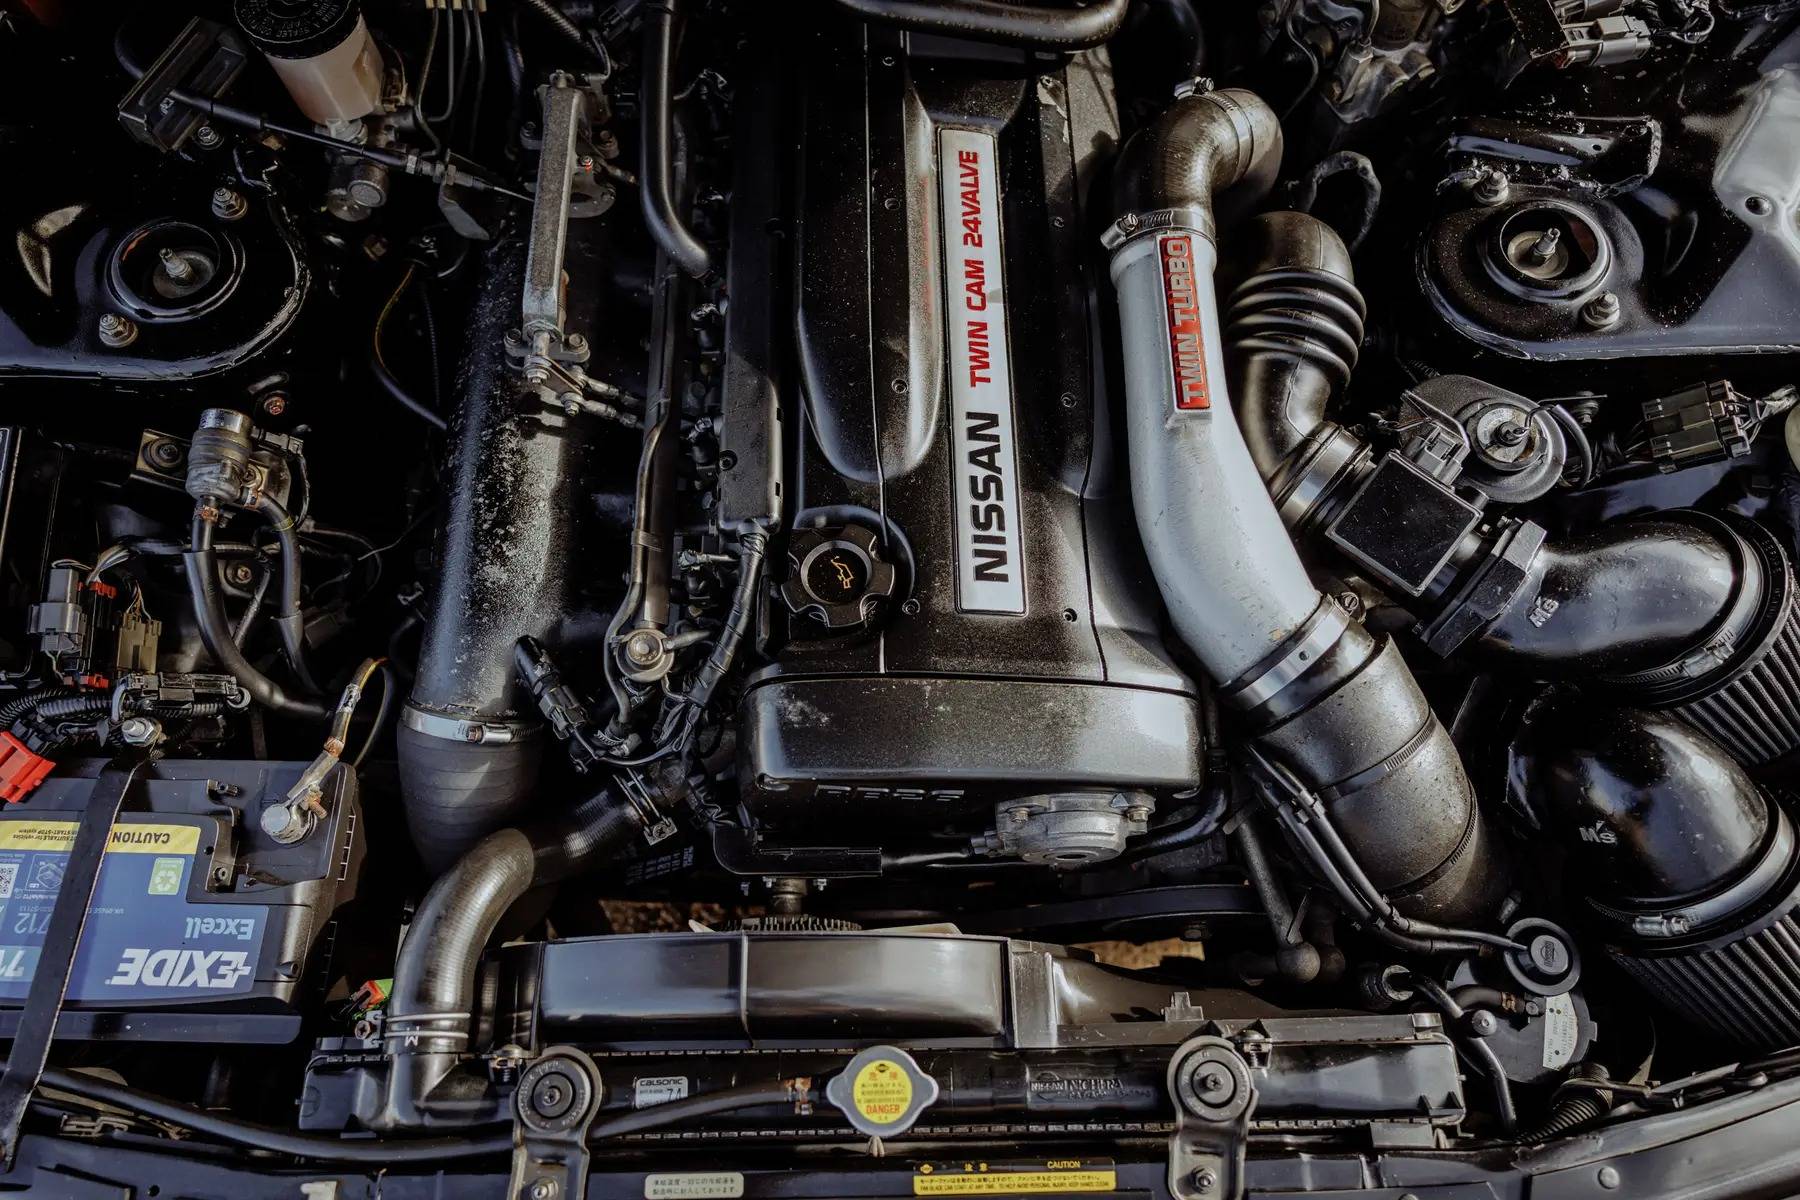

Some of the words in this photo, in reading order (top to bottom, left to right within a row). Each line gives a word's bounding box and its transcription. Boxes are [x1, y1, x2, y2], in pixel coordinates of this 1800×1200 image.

[960, 150, 983, 248] 24VALVE
[966, 260, 988, 312] CAM
[1167, 239, 1195, 326] TURBO
[971, 321, 991, 388] TWIN
[1177, 333, 1204, 404] TWIN
[966, 411, 1009, 583] NISSAN
[112, 832, 170, 844] CAUTION
[185, 917, 255, 940] Excell
[110, 948, 251, 988] EXIDE
[866, 1104, 900, 1114] DANGER
[1047, 1161, 1081, 1169] CAUTION
